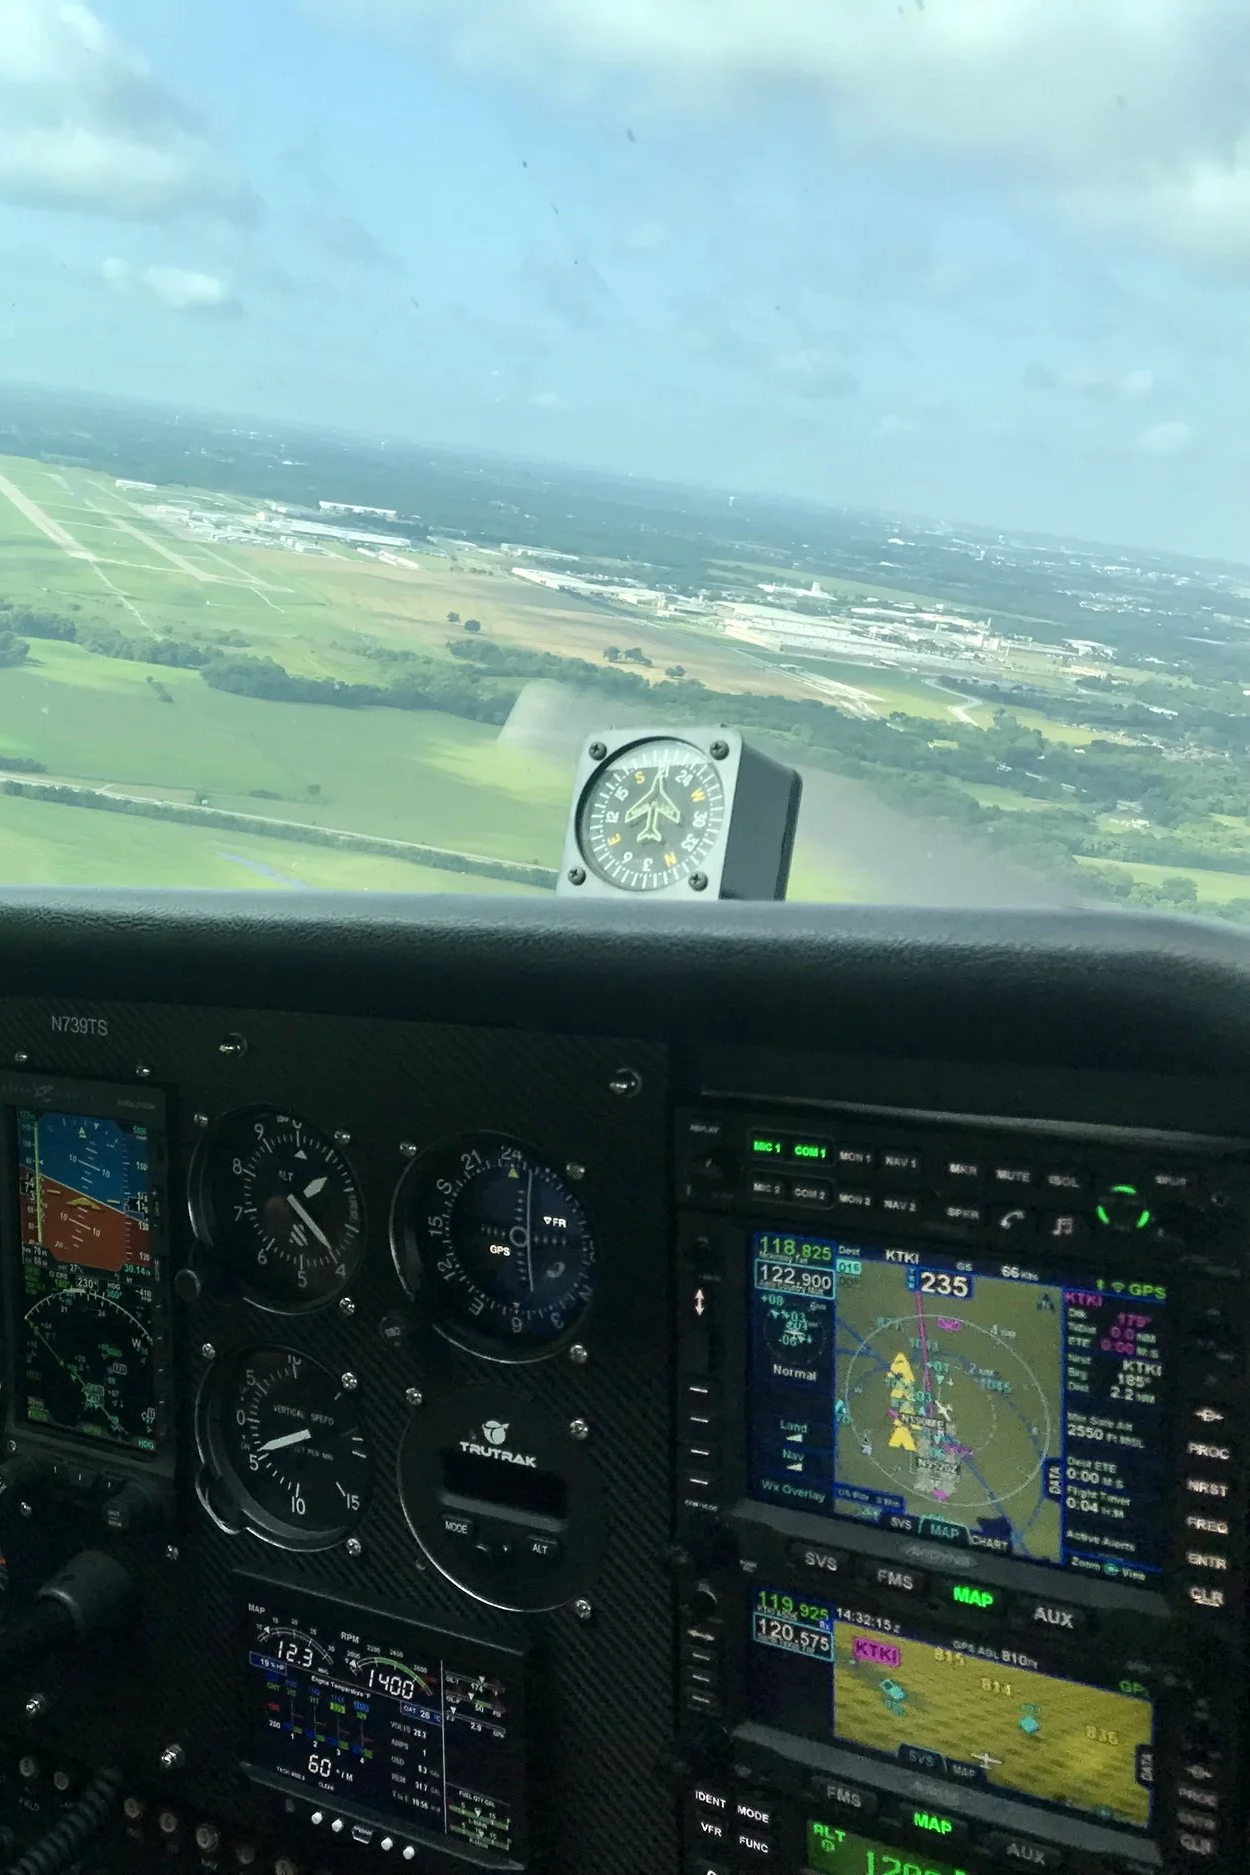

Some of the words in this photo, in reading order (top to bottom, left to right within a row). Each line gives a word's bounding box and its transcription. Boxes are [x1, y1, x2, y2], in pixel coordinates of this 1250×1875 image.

[675, 769, 693, 787] 24
[51, 1015, 108, 1036] N739TS
[254, 1123, 265, 1140] 9
[775, 1143, 781, 1153] 1
[794, 1145, 819, 1158] COM
[820, 1148, 826, 1158] 1
[232, 1158, 243, 1175] 8
[794, 1188, 817, 1199] COM
[233, 1205, 243, 1222] 7
[257, 1248, 268, 1265] 6
[489, 1244, 511, 1257] GPS
[760, 1235, 832, 1261] 118.825
[885, 1249, 920, 1265] KTKI
[298, 1271, 307, 1288] 5
[335, 1264, 346, 1278] 4
[760, 1264, 832, 1290] 122.900
[920, 1271, 969, 1298] 235
[1128, 1283, 1166, 1300] GPS
[246, 1369, 256, 1386] 5
[773, 1364, 817, 1381] Normal
[780, 1419, 808, 1433] Land
[1067, 1424, 1104, 1441] 2550
[459, 1441, 537, 1468] TRUTRAK
[782, 1449, 805, 1462] Nav
[1188, 1442, 1230, 1460] PROC
[249, 1454, 259, 1471] 5
[1049, 1466, 1061, 1495] DATA
[1186, 1479, 1228, 1497] NRST
[761, 1479, 781, 1493] Wx
[783, 1483, 826, 1503] Overlay
[291, 1496, 306, 1515] 10
[347, 1493, 361, 1511] 15
[445, 1520, 468, 1534] MODE
[890, 1517, 912, 1530] SVS
[930, 1524, 960, 1539] MAP
[532, 1543, 548, 1555] ALT
[805, 1552, 838, 1572] SVS
[876, 1568, 913, 1590] FMS
[953, 1585, 994, 1608] MAP
[758, 1590, 829, 1621] 119.925
[836, 1608, 891, 1631] 14:32:15
[1033, 1606, 1074, 1629] AUX
[340, 1631, 360, 1643] RPM
[758, 1618, 830, 1651] 120.575
[278, 1640, 313, 1668] 12.3
[855, 1641, 897, 1662] KTKI
[368, 1669, 415, 1700] 1400
[308, 1754, 332, 1778] 60
[908, 1750, 935, 1768] SVS
[952, 1764, 975, 1777] MAP
[695, 1789, 726, 1809] IDENT
[826, 1785, 862, 1808] FMS
[737, 1804, 770, 1824] MODE
[913, 1811, 953, 1835] MAP
[700, 1822, 722, 1838] VFR
[739, 1835, 768, 1853] FUNC
[1007, 1842, 1046, 1866] AUX
